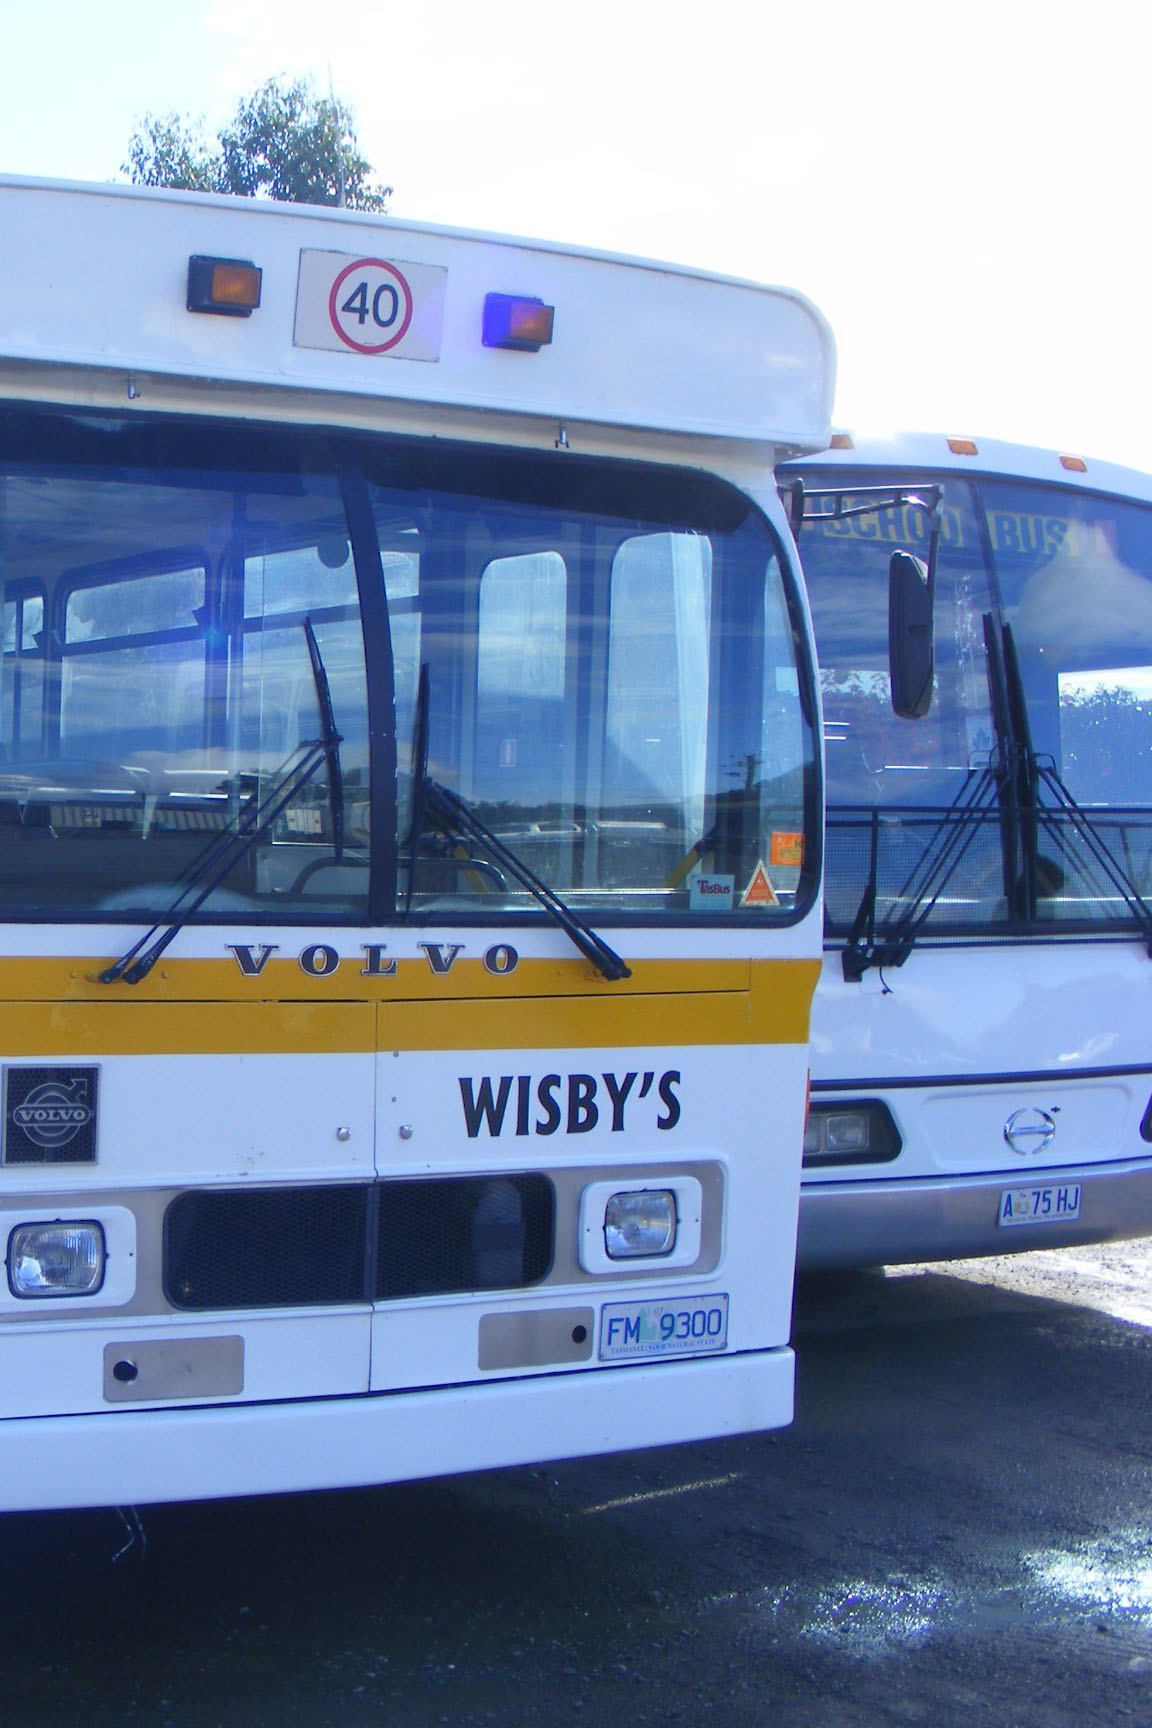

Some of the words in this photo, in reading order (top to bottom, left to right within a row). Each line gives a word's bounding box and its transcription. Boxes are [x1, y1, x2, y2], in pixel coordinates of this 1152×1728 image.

[341, 282, 399, 328] 40
[995, 514, 1070, 555] BUS
[226, 942, 520, 978] VOLVO
[18, 1109, 86, 1122] VOLVO
[459, 1070, 682, 1139] WISBY'S
[1002, 1193, 1013, 1218] A
[1031, 1189, 1053, 1215] 75
[1056, 1187, 1079, 1212] HJ
[607, 1316, 641, 1346] FM
[659, 1308, 723, 1341] 9300
